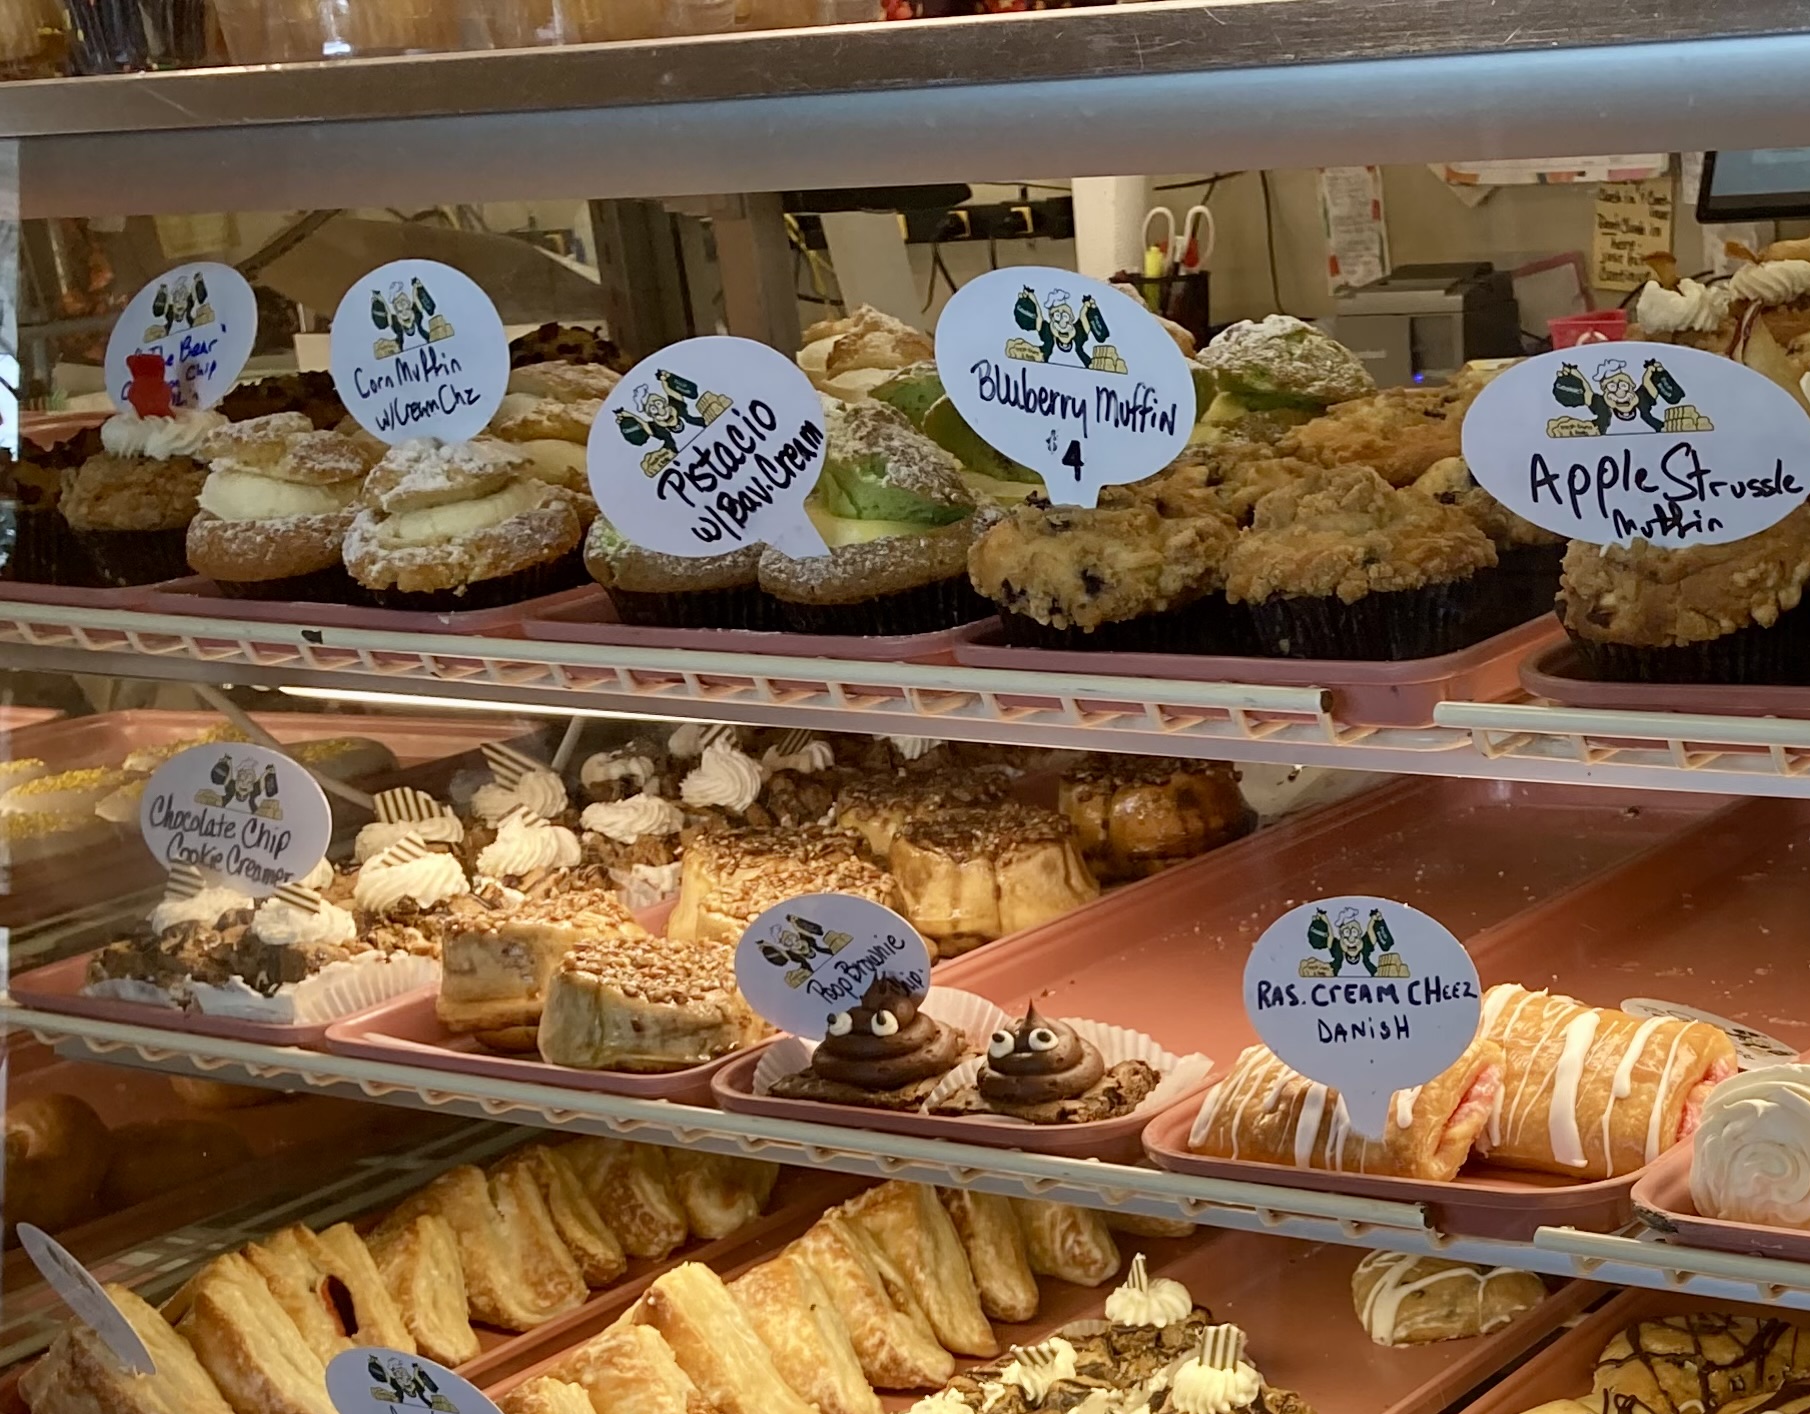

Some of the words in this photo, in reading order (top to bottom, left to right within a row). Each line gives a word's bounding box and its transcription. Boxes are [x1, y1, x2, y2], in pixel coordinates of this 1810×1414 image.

[657, 399, 776, 507] Pistacio
[1530, 449, 1659, 519] Apple
[1660, 442, 1804, 501] Strussle
[150, 793, 236, 838] Chocolate
[241, 818, 291, 859] Chip
[167, 832, 223, 871] Cookie
[834, 934, 906, 982] Brownie
